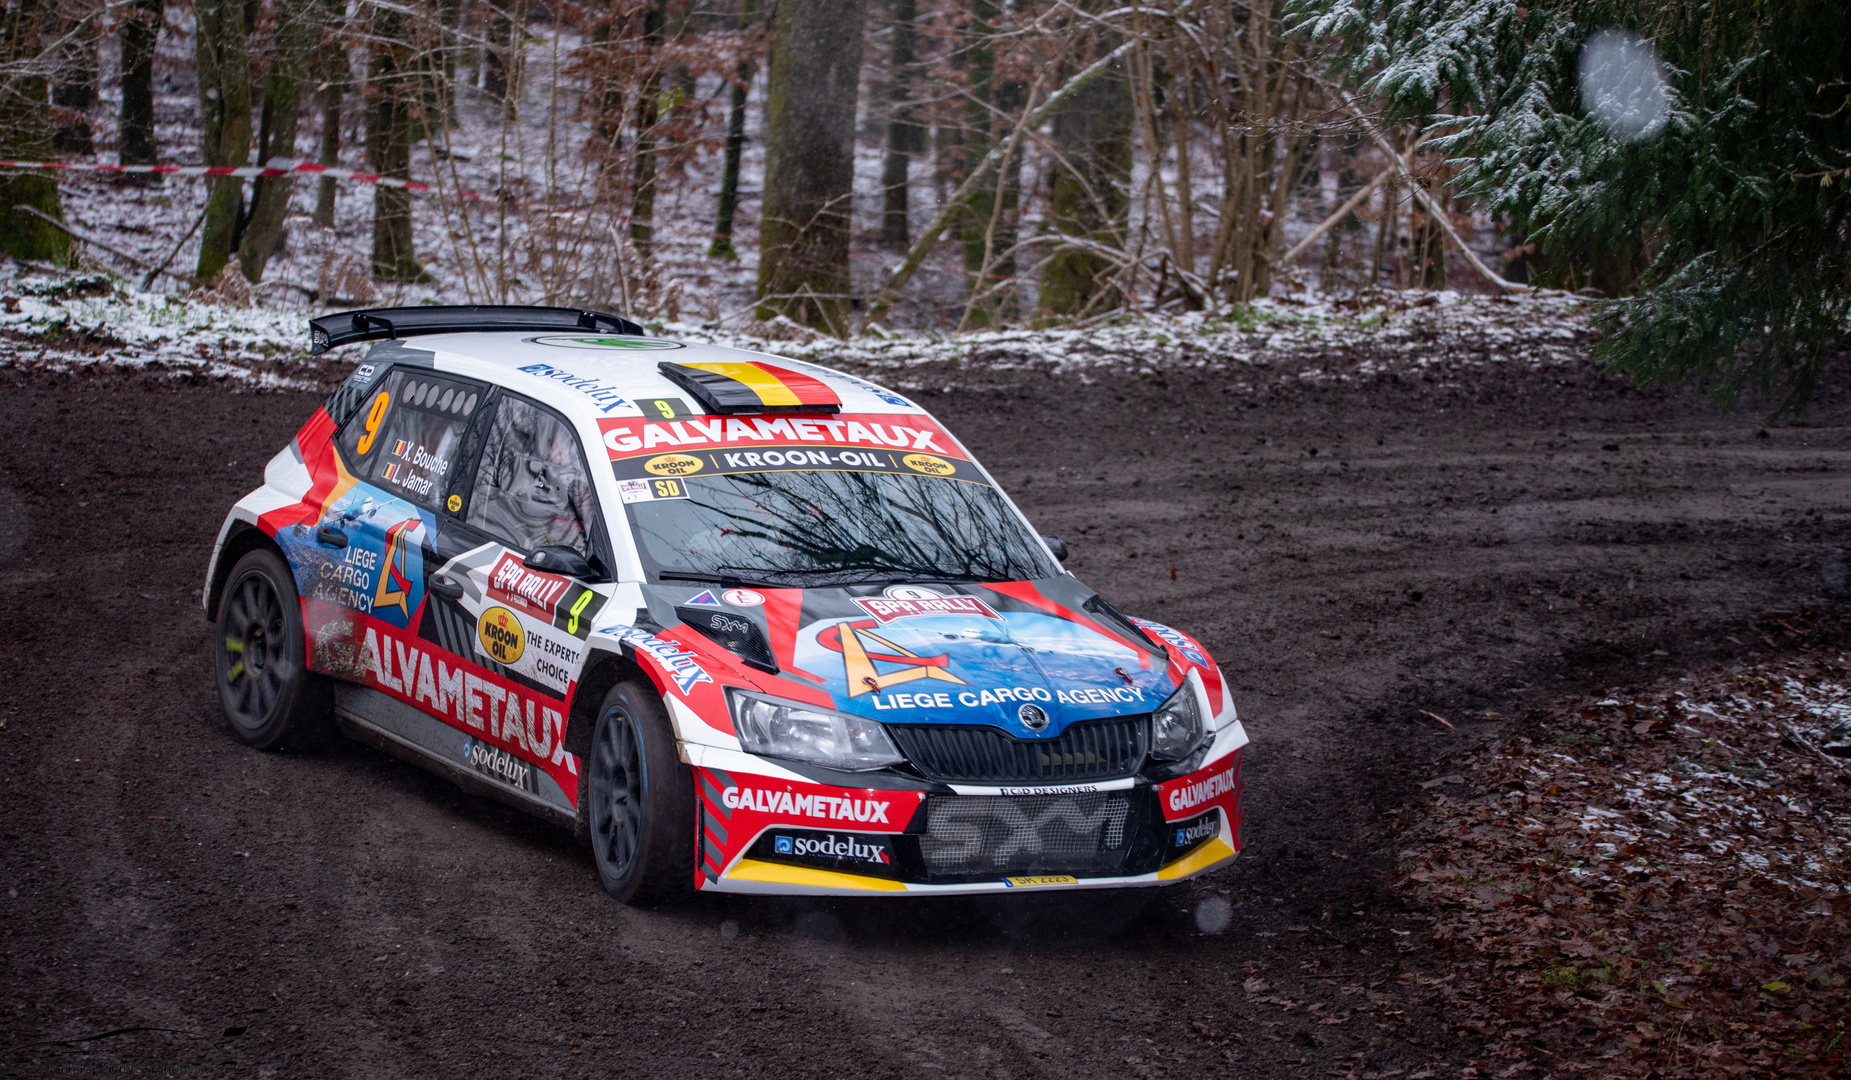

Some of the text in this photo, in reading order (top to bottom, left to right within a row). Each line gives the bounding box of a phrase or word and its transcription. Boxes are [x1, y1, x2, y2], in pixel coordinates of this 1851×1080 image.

[533, 370, 633, 414] sodelux
[357, 391, 390, 455] 9
[654, 400, 676, 419] 9
[603, 418, 948, 454] GALVAMETAUX
[401, 441, 448, 476] X. Bouche
[652, 460, 695, 470] KROON
[667, 467, 687, 475] OIL
[724, 450, 886, 468] KROON-OIL
[910, 460, 948, 470] KROON
[391, 464, 433, 496] L. Jamar
[654, 480, 680, 497] SD
[345, 545, 377, 571] LIEGE
[320, 561, 370, 590] CARGO
[494, 558, 525, 591] SPA
[517, 573, 563, 611] RALLY
[312, 582, 374, 614] AGENCY
[568, 590, 594, 634] 9
[867, 598, 984, 616] SPA RALLY
[484, 621, 518, 649] KROON
[527, 630, 543, 649] THE
[492, 641, 507, 660] OIL
[536, 659, 569, 684] CHOICE
[871, 687, 1146, 710] LIEGE CARGO AGENCY
[470, 745, 528, 789] sodelux
[1034, 785, 1098, 794] DESIGNERS
[1169, 767, 1235, 811] GALVAMETAUX
[722, 786, 890, 824] GALVAMETAUX
[794, 834, 885, 863] sodelux
